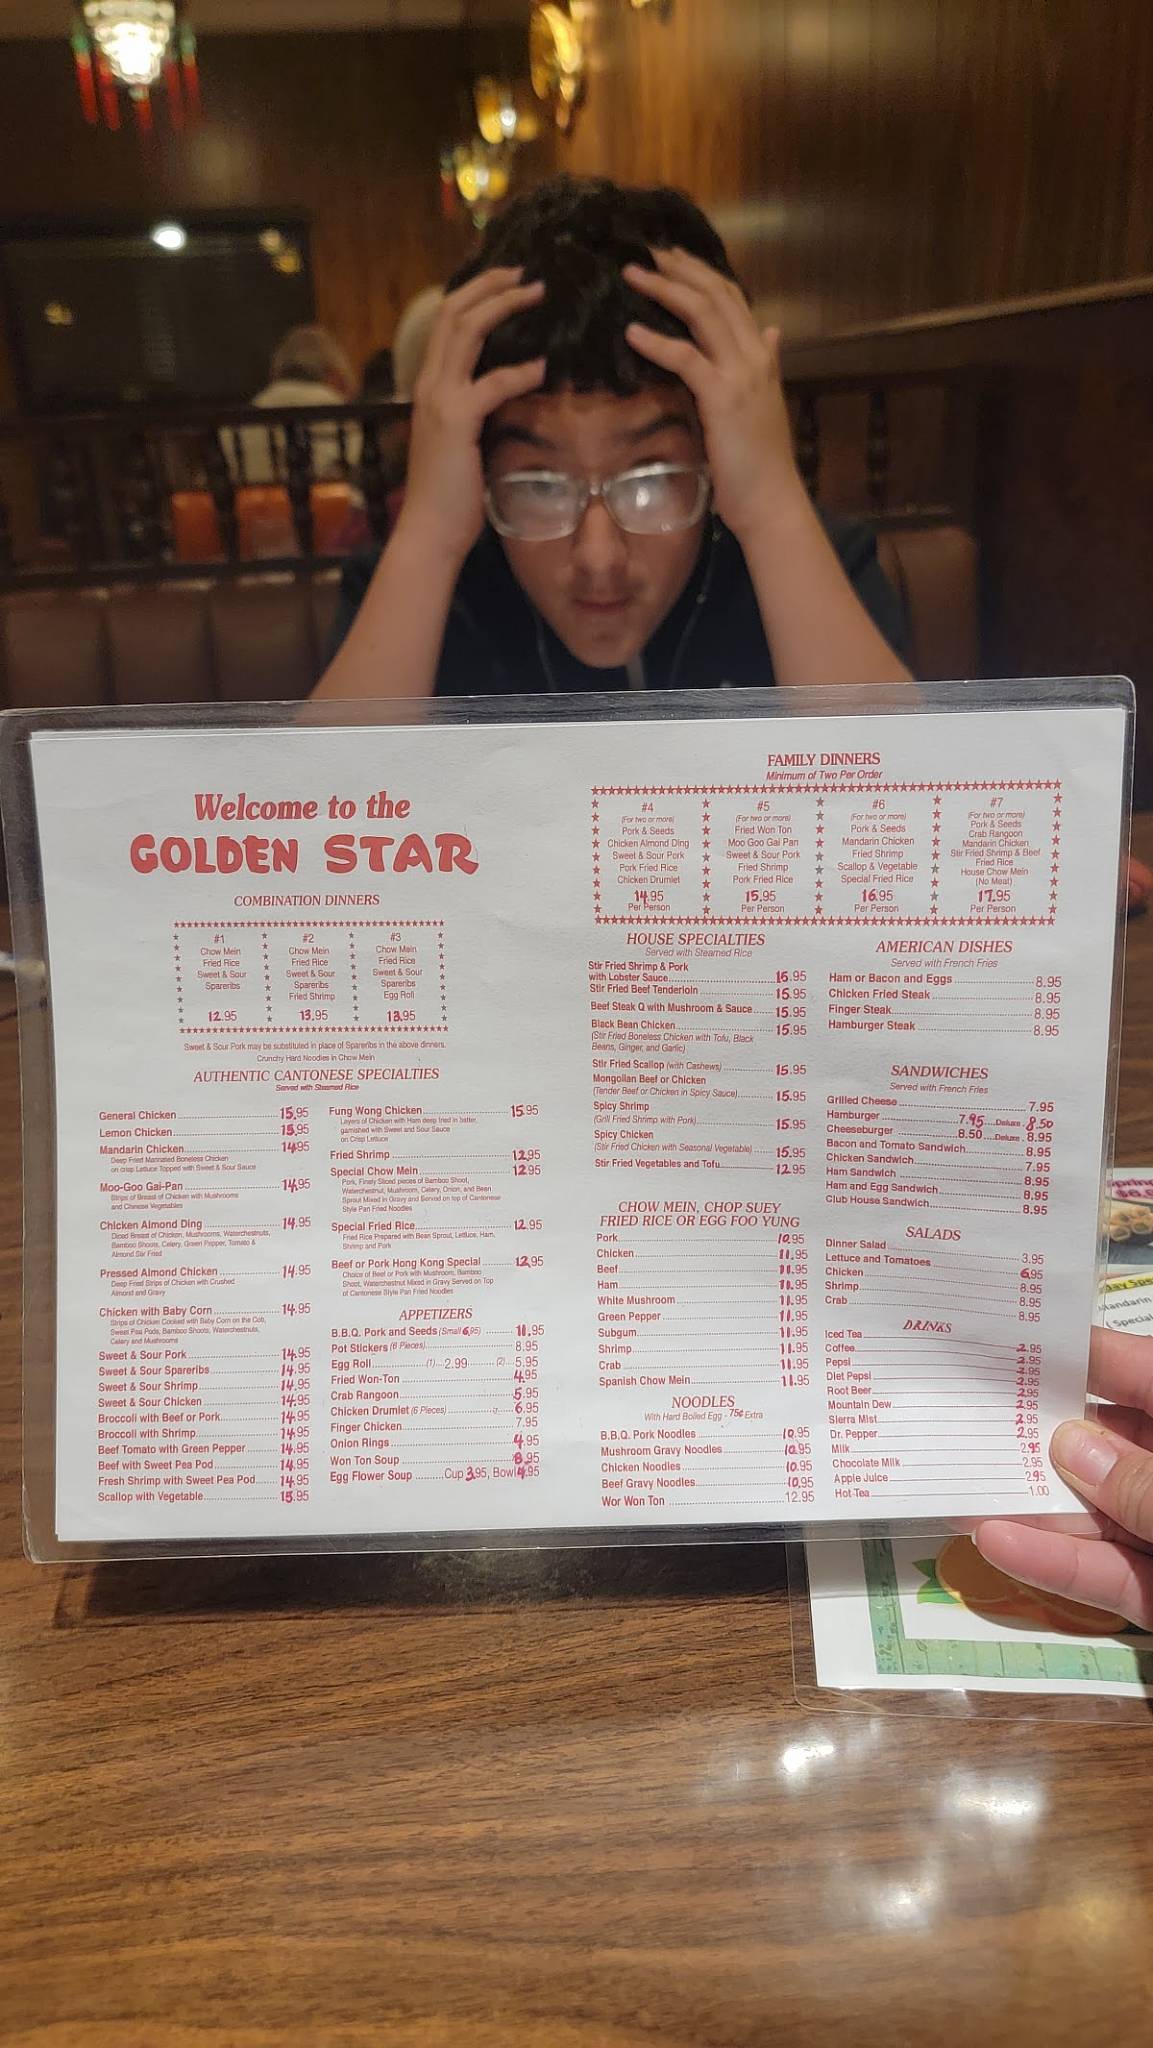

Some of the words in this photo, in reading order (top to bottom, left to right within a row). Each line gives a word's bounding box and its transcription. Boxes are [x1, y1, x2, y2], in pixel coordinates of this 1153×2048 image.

[768, 754, 816, 766] FAMILY
[820, 752, 880, 765] DINNERS
[766, 771, 805, 780] Minimum
[808, 771, 816, 779] of
[819, 770, 837, 779] Two
[840, 770, 855, 779] Per
[857, 770, 883, 779] Order
[195, 793, 318, 820] Welcome
[328, 795, 356, 819] to
[367, 791, 410, 818] the
[642, 803, 653, 812] #4
[757, 801, 769, 811] #5
[873, 799, 885, 809] #6
[990, 797, 1003, 808] #7
[622, 826, 641, 835] Pork
[642, 826, 647, 835] &
[650, 827, 674, 835] Seeds
[608, 839, 638, 847] Chicken
[640, 839, 668, 847] Almond
[669, 839, 689, 850] Ding
[842, 837, 879, 845] Mandarin
[882, 837, 914, 845] Chicken
[130, 834, 298, 874] GOLDEN
[324, 833, 479, 875] STAR
[853, 849, 872, 858] Fried
[875, 849, 903, 861] Shrimp
[837, 862, 866, 872] Scallop
[869, 862, 874, 870] &
[878, 862, 918, 873] Vegetable
[234, 895, 320, 906] COMBINATION
[325, 895, 379, 905] DINNERS
[628, 902, 641, 911] Per
[643, 902, 670, 911] Person
[214, 934, 224, 943] #1
[303, 934, 314, 943] #2
[391, 933, 401, 941] #3
[627, 933, 674, 945] HOUSE
[678, 933, 765, 945] SPECIALTIES
[201, 947, 221, 955] Chow
[224, 947, 241, 955] Mein
[876, 941, 954, 952] AMERICAN
[959, 941, 1012, 953] DISHES
[645, 948, 674, 958] Served
[676, 948, 692, 956] with
[695, 948, 732, 957] Steamed
[734, 948, 752, 957] Rice
[203, 959, 220, 967] Fried
[891, 958, 922, 967] Served
[925, 959, 942, 967] with
[944, 958, 974, 967] French
[977, 958, 998, 967] Fries
[198, 971, 219, 979] Sweet
[229, 970, 246, 978] Sour
[830, 973, 851, 982] Ham
[869, 973, 900, 983] Bacon
[904, 974, 923, 983] and
[926, 974, 952, 985] Eggs
[1036, 976, 1061, 987] 8.95
[205, 982, 240, 991] Spareribs
[384, 991, 398, 1000] Egg
[401, 991, 414, 999] Roll
[591, 1002, 609, 1010] Beef
[613, 1002, 635, 1011] Steak
[647, 1003, 665, 1011] with
[668, 1003, 714, 1012] Mushroom
[717, 1004, 723, 1012] &
[725, 1004, 752, 1013] Sauce
[209, 1011, 237, 1022] 12.95
[608, 1031, 626, 1040] Fried
[628, 1032, 661, 1040] Boneless
[663, 1033, 693, 1042] Chicken
[696, 1033, 710, 1041] with
[733, 1034, 753, 1043] Black
[194, 1071, 270, 1082] AUTHENTIC
[274, 1069, 353, 1081] CANTONESE
[357, 1067, 439, 1080] SPECIALTIES
[891, 1065, 988, 1079] SANDWICHES
[99, 1112, 135, 1120] General
[139, 1111, 176, 1119] Chicken
[329, 1107, 352, 1117] Fung
[355, 1106, 383, 1117] Wong
[385, 1106, 422, 1114] Chicken
[595, 1130, 617, 1141] Spicy
[620, 1130, 653, 1139] Chicken
[827, 1124, 893, 1136] Cheeseburger
[958, 1128, 982, 1139] 8.50
[1026, 1131, 1052, 1142] 8.95
[619, 1201, 661, 1214] CHOW
[662, 1201, 699, 1215] MEIN,
[704, 1202, 742, 1214] CHOP
[746, 1202, 781, 1213] SUEY
[826, 1195, 848, 1203] Club
[850, 1196, 880, 1204] House
[883, 1197, 929, 1207] Sandwich
[1023, 1205, 1047, 1215] 8.95
[100, 1221, 138, 1230] Chicken
[141, 1220, 177, 1229] Almond
[181, 1219, 202, 1232] Ding
[906, 1226, 961, 1241] SALADS
[826, 1253, 860, 1262] Lettuce
[863, 1255, 880, 1263] and
[884, 1255, 931, 1266] Tomatoes
[399, 1307, 472, 1320] APPETIZERS
[902, 1320, 952, 1333] DRINKS
[332, 1344, 347, 1353] Pot
[350, 1343, 388, 1353] Stickers
[516, 1340, 538, 1351] 8.95
[332, 1360, 349, 1370] Egg
[353, 1359, 371, 1368] Roll
[443, 1358, 469, 1369] 2.99
[515, 1356, 538, 1367] 5.95
[672, 1395, 736, 1410] NOODLES
[828, 1400, 869, 1409] Mountain
[872, 1400, 891, 1408] Dew
[833, 1459, 879, 1468] Chocolate
[881, 1458, 900, 1467] Milk
[1021, 1457, 1043, 1469] 2.95
[99, 1476, 124, 1485] Fresh
[128, 1476, 160, 1487] Shrimp
[163, 1476, 183, 1485] with
[186, 1476, 214, 1485] Sweet
[217, 1475, 234, 1484] Pea
[237, 1475, 255, 1484] Pod
[98, 1492, 133, 1503] Scallop
[136, 1492, 154, 1501] with
[158, 1491, 203, 1503] Vegetable
[602, 1496, 621, 1506] Wor
[624, 1496, 645, 1506] Won
[648, 1495, 664, 1505] Ton
[785, 1491, 814, 1503] 12.95
